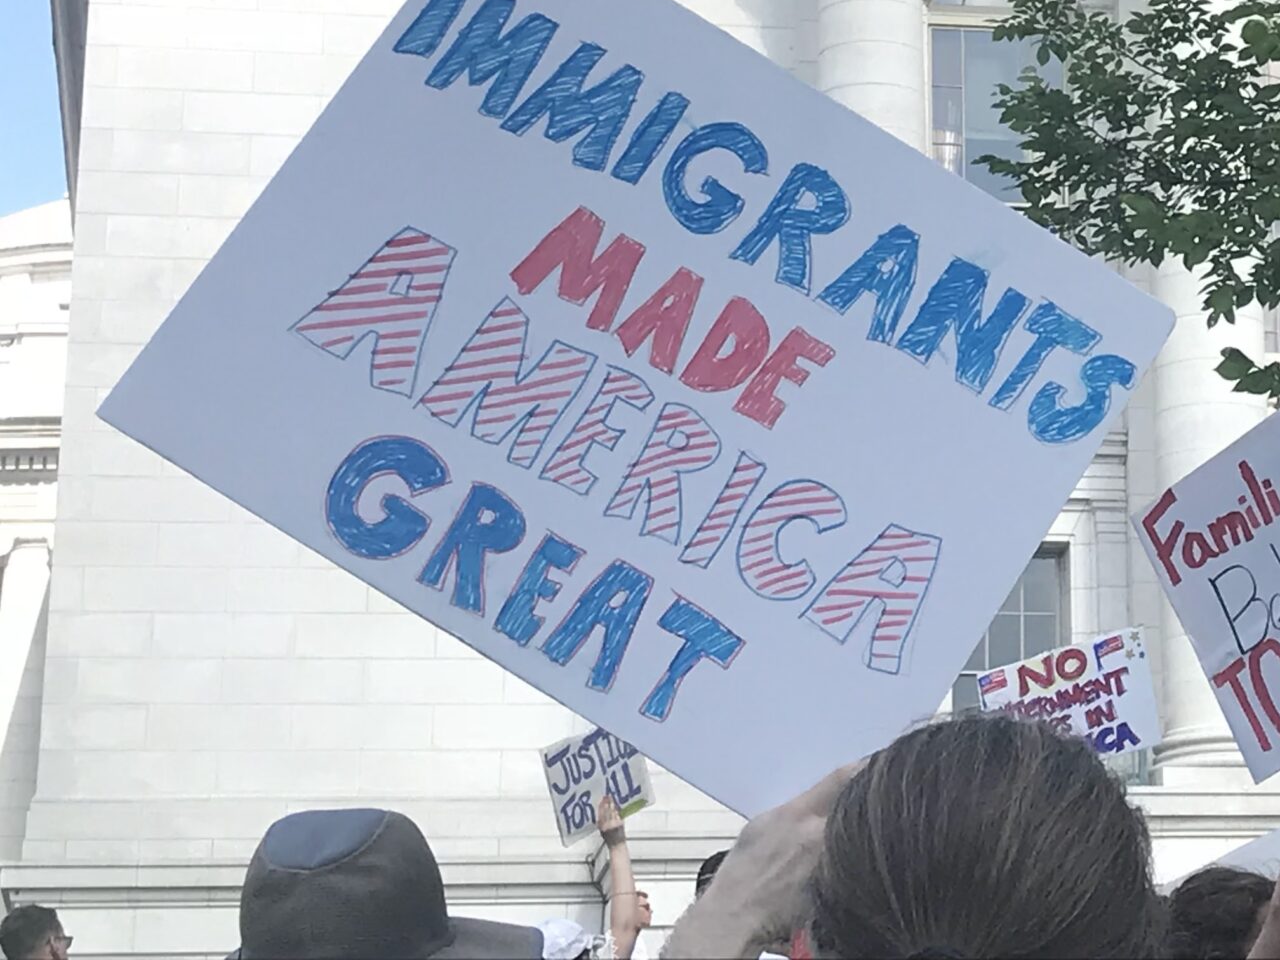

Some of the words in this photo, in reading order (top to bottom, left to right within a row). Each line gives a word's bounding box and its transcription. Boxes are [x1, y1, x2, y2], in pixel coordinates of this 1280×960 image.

[510, 206, 836, 429] MADE
[287, 226, 942, 675] AMERICA
[324, 434, 747, 723] GREAT
[1001, 666, 1130, 721] NTERNMENT
[1016, 648, 1088, 698] NO
[1084, 700, 1117, 730] IN
[561, 790, 596, 835] FOR
[605, 761, 642, 811] ALL
